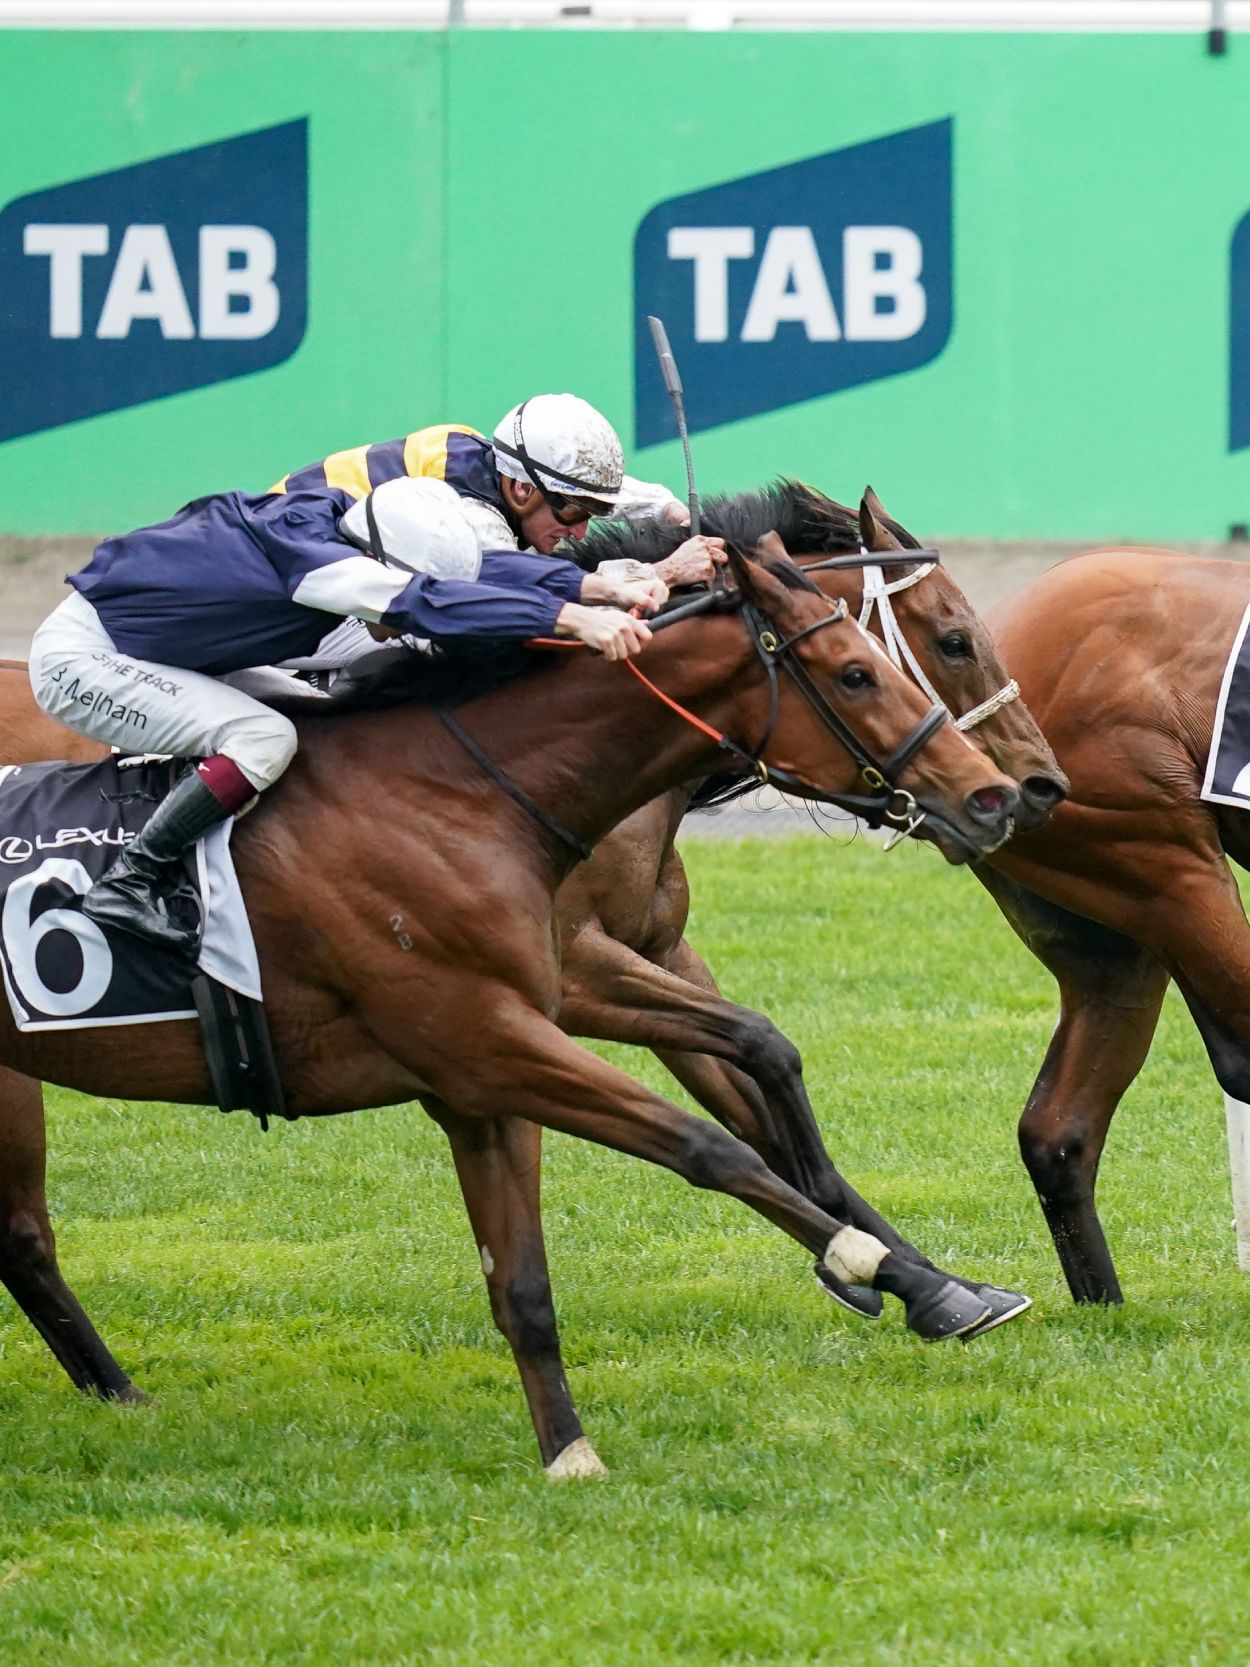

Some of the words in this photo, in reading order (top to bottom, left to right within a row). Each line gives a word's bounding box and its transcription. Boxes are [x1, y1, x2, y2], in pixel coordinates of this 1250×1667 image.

[23, 224, 281, 339] TAB
[668, 226, 928, 342] TAB
[2, 857, 113, 1017] 6
